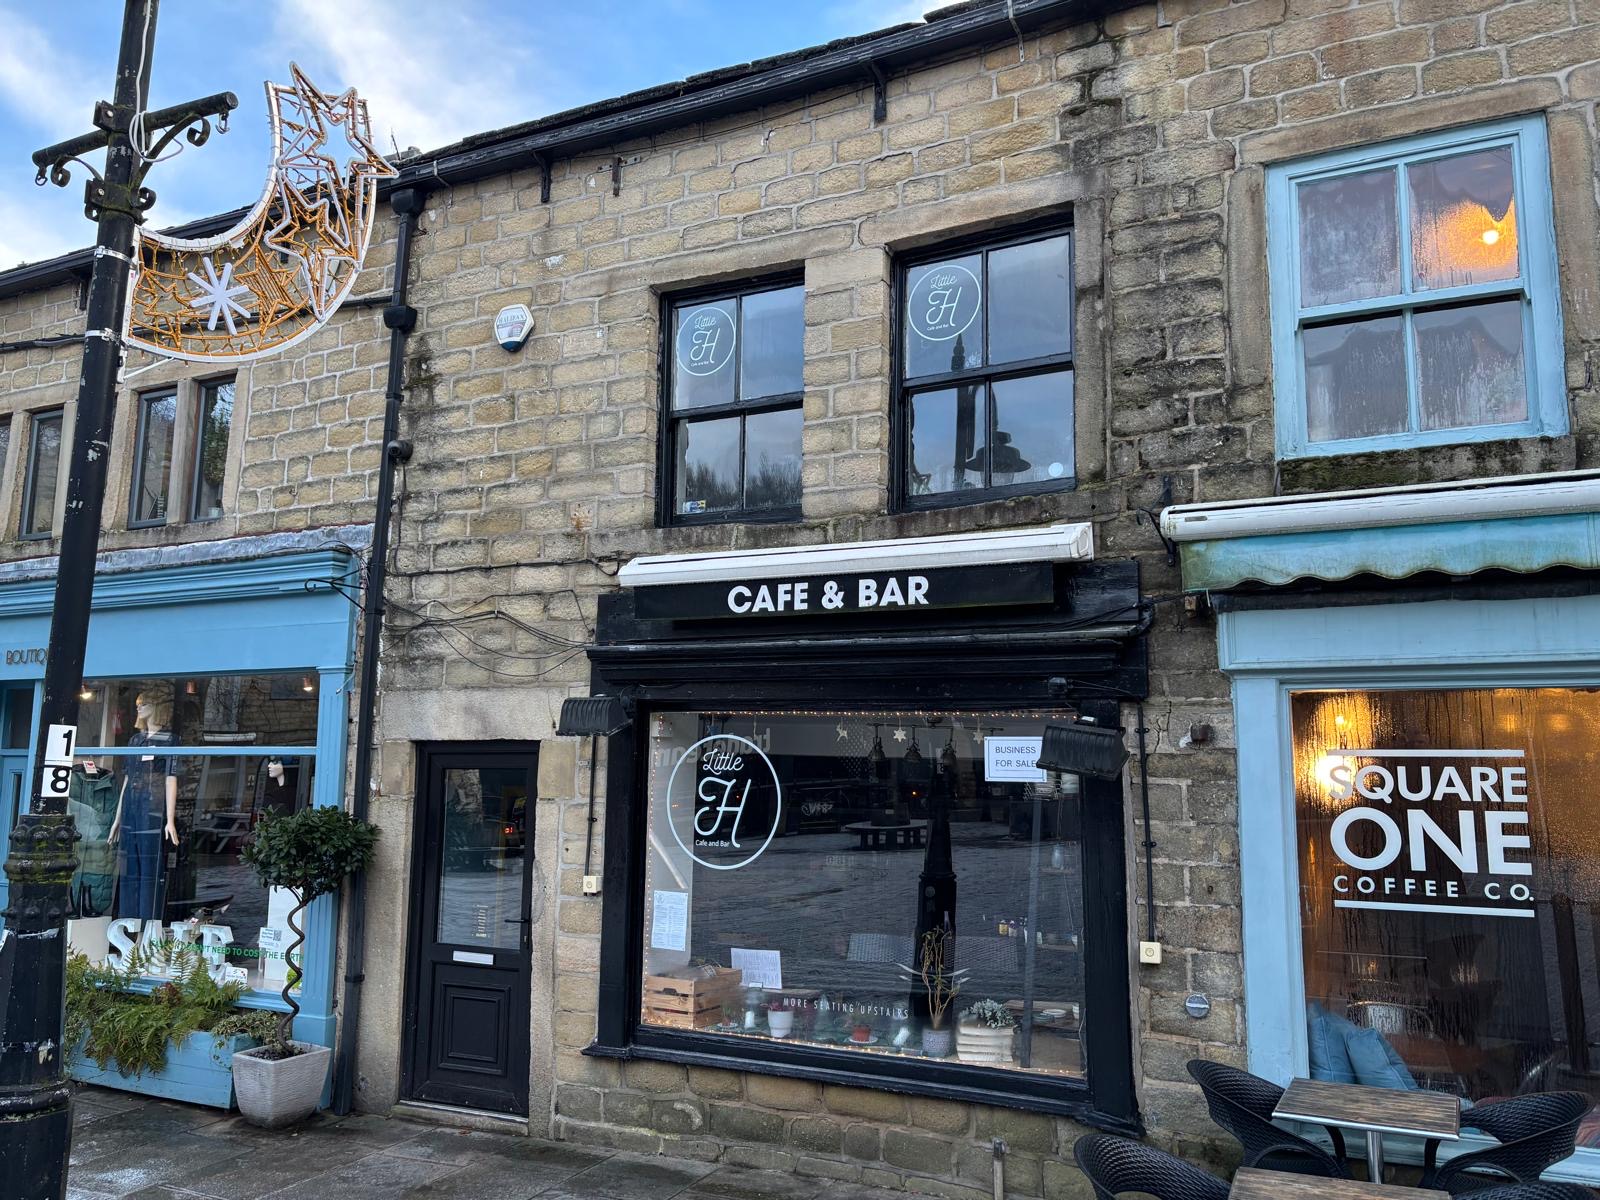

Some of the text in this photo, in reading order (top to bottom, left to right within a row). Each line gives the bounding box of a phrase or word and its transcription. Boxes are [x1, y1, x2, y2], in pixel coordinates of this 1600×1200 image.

[930, 274, 958, 289] Little
[727, 575, 929, 614] CAFE & BAR
[6, 648, 48, 665] BOUTIQ
[63, 729, 73, 757] 1
[995, 746, 1037, 754] BUSINESS
[702, 748, 744, 775] Little
[1015, 760, 1037, 768] SALE
[50, 766, 71, 794] 8
[1329, 765, 1528, 804] SQUARE
[695, 839, 708, 847] Cafe
[1330, 807, 1533, 876] ONE
[1333, 875, 1535, 902] COFFEE CO.
[211, 945, 231, 955] NEED
[233, 948, 243, 956] TO
[265, 951, 279, 960] THE
[783, 998, 909, 1019] MORE SEATING UPSTAIRS
